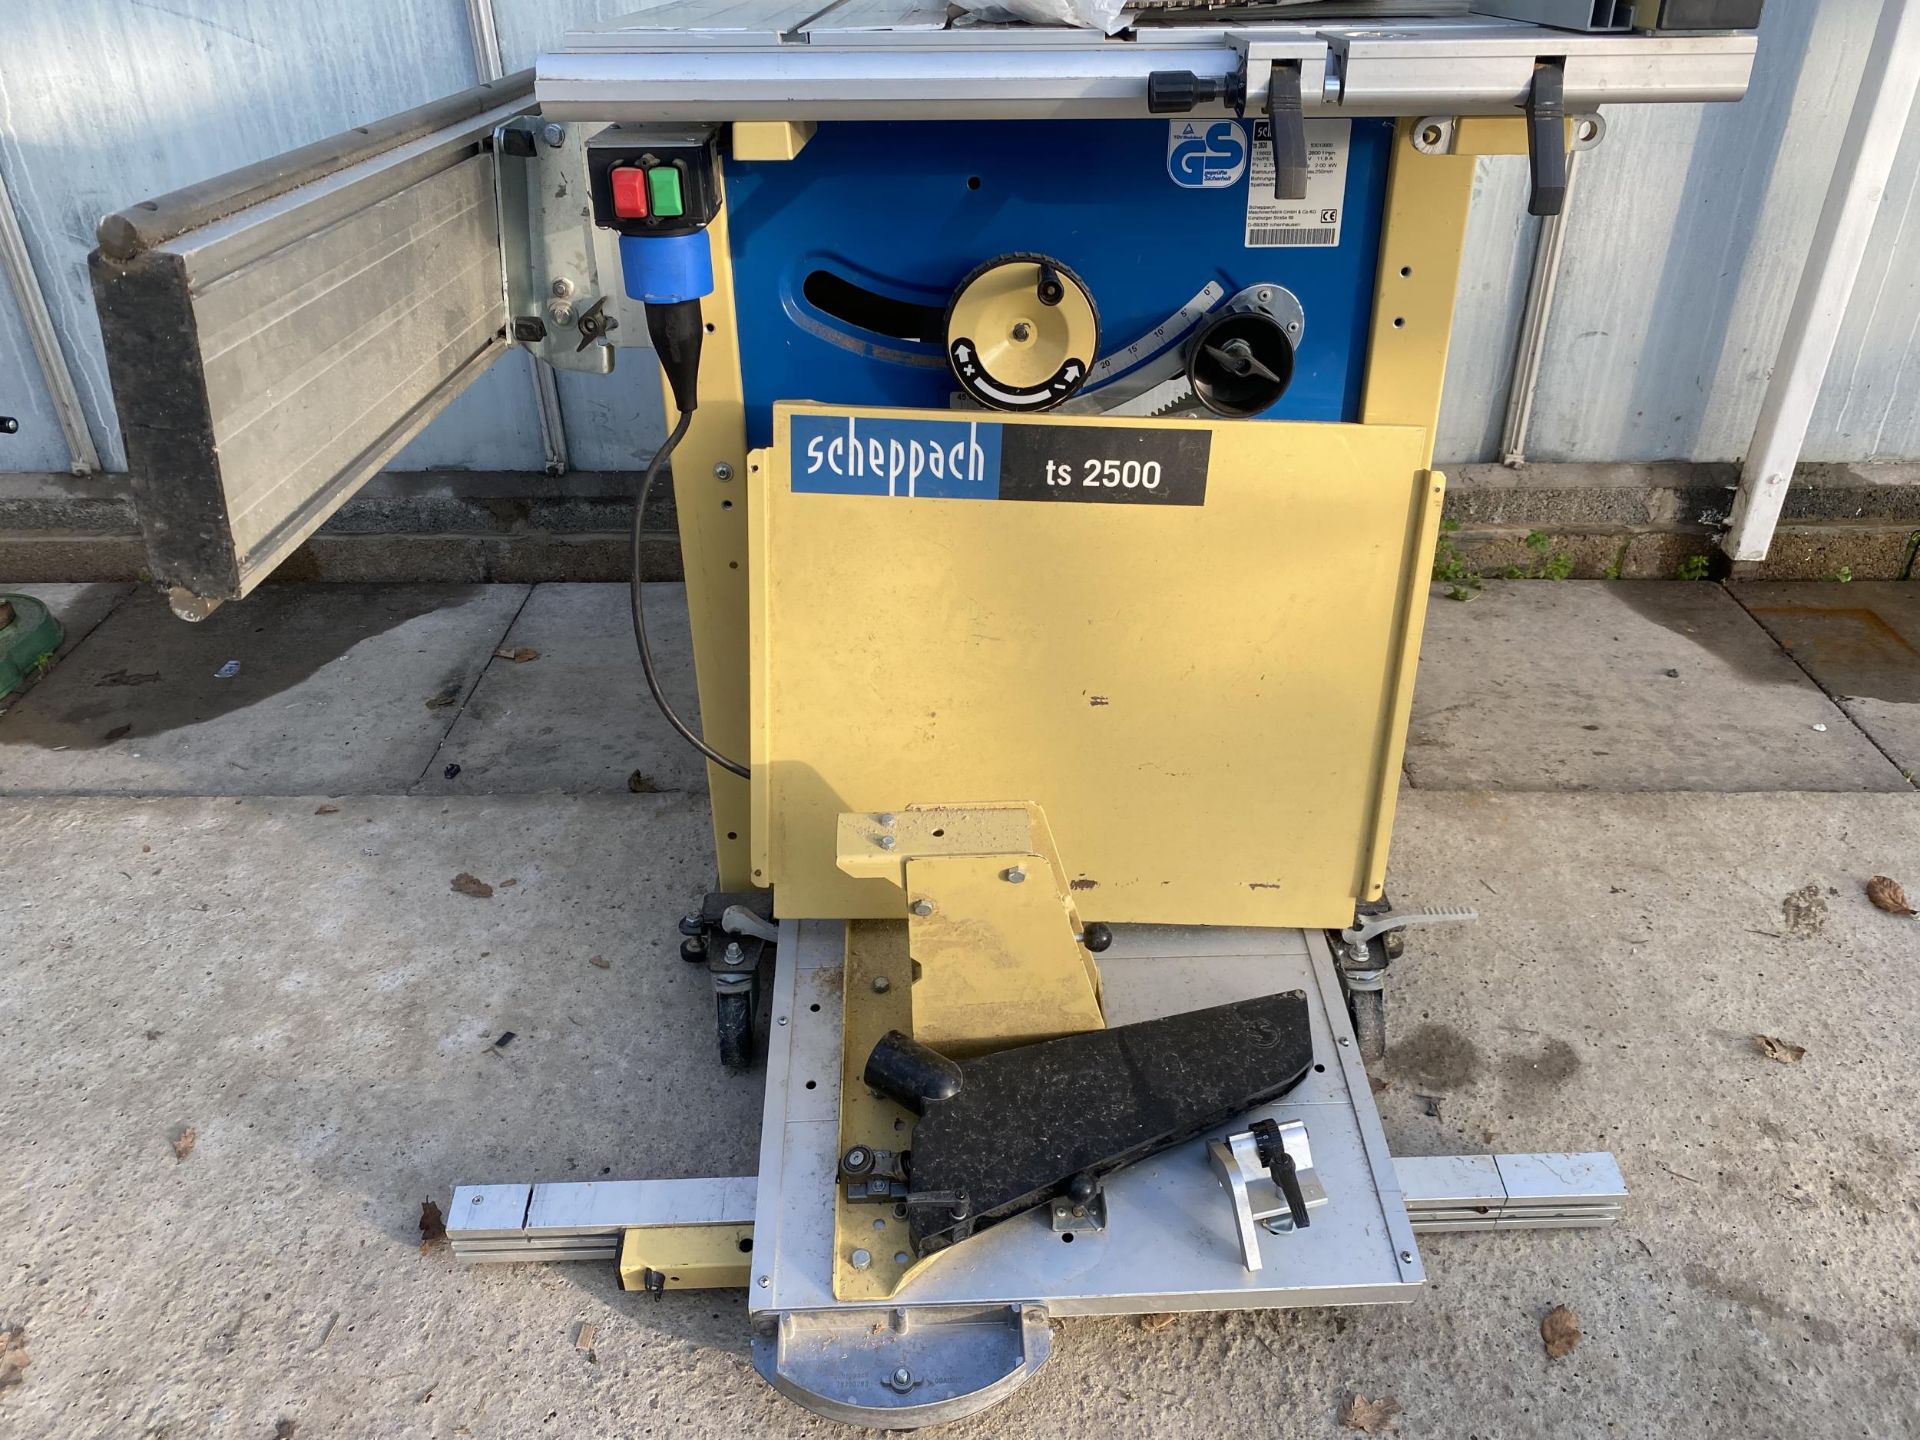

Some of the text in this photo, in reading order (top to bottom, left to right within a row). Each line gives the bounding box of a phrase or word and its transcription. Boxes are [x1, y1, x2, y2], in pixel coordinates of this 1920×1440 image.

[808, 417, 1161, 497] scheppach ts 2500
